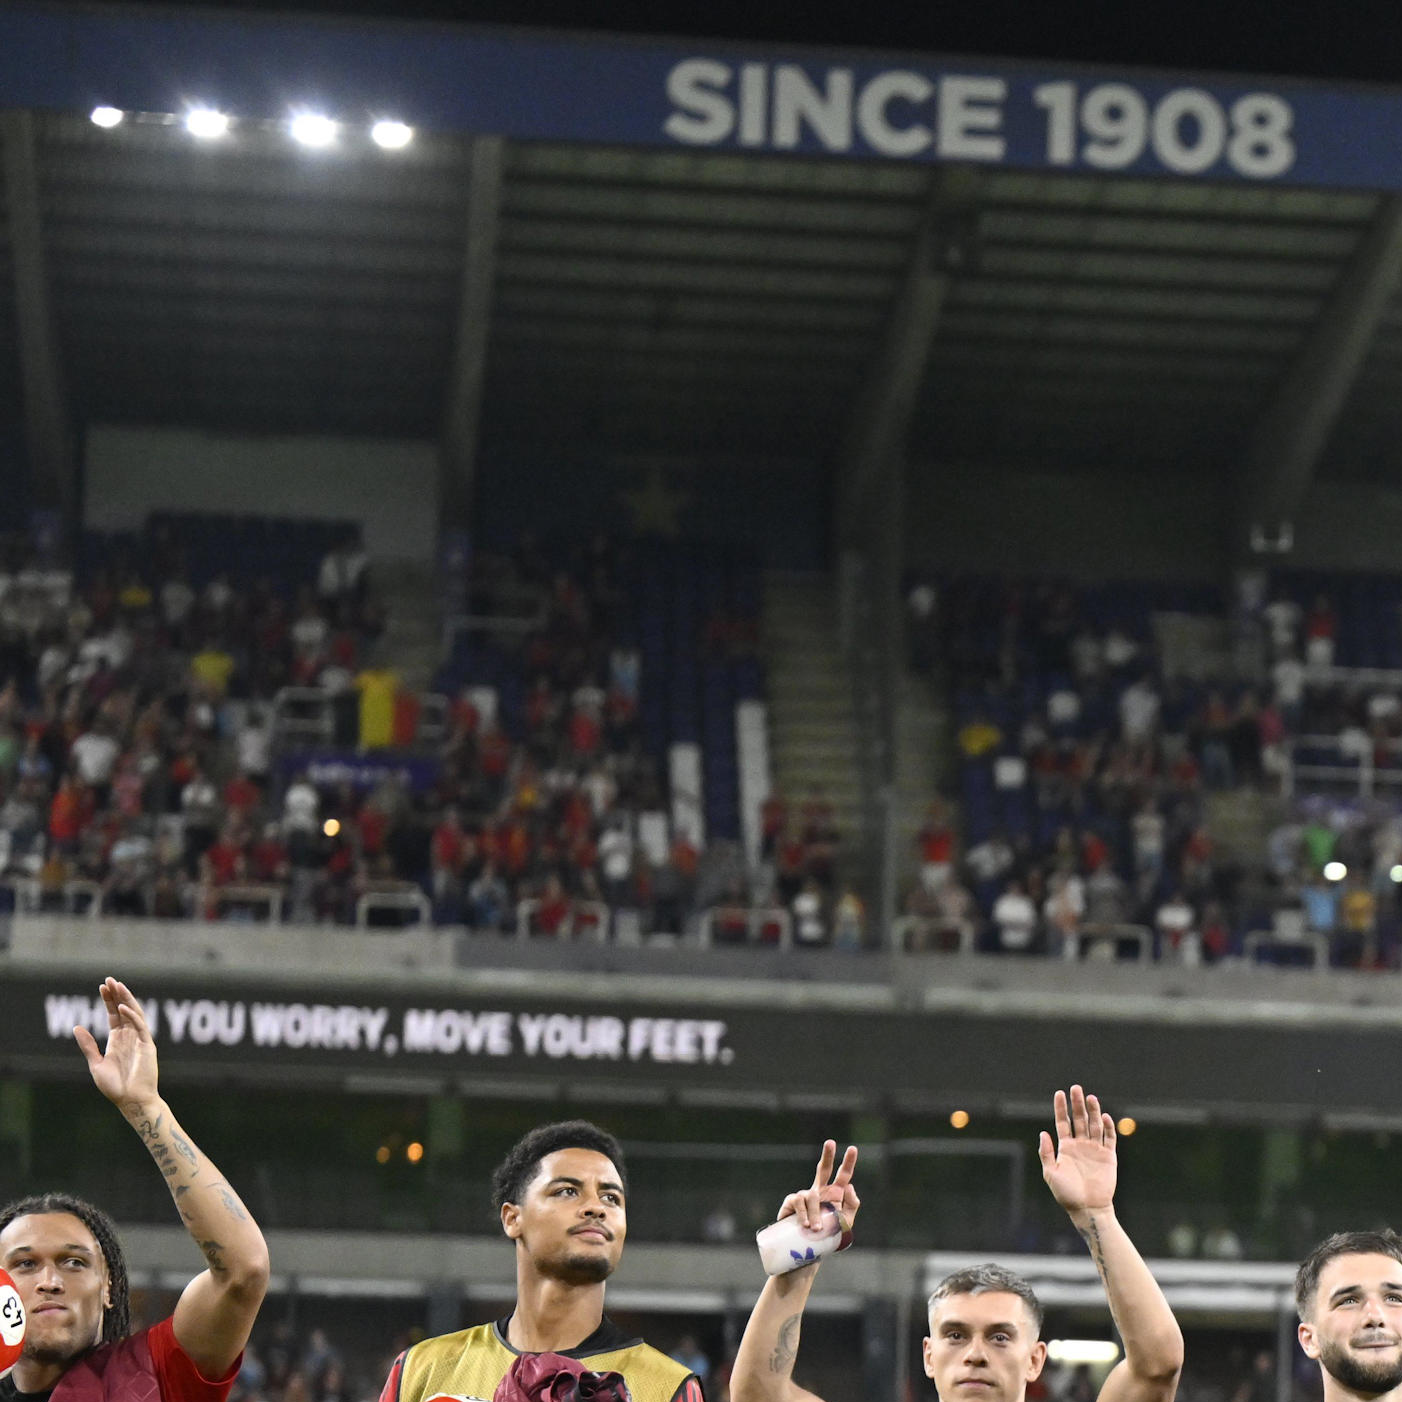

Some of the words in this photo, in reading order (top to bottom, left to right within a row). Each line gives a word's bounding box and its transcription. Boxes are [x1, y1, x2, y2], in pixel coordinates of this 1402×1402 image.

[664, 58, 1006, 158] SINCE
[1034, 80, 1296, 179] 1908
[164, 1000, 245, 1045] YOU
[251, 1003, 398, 1055] WORRY,
[403, 1008, 513, 1055] MOVE
[520, 1014, 625, 1061] YOUR
[627, 1019, 735, 1065] FEET.
